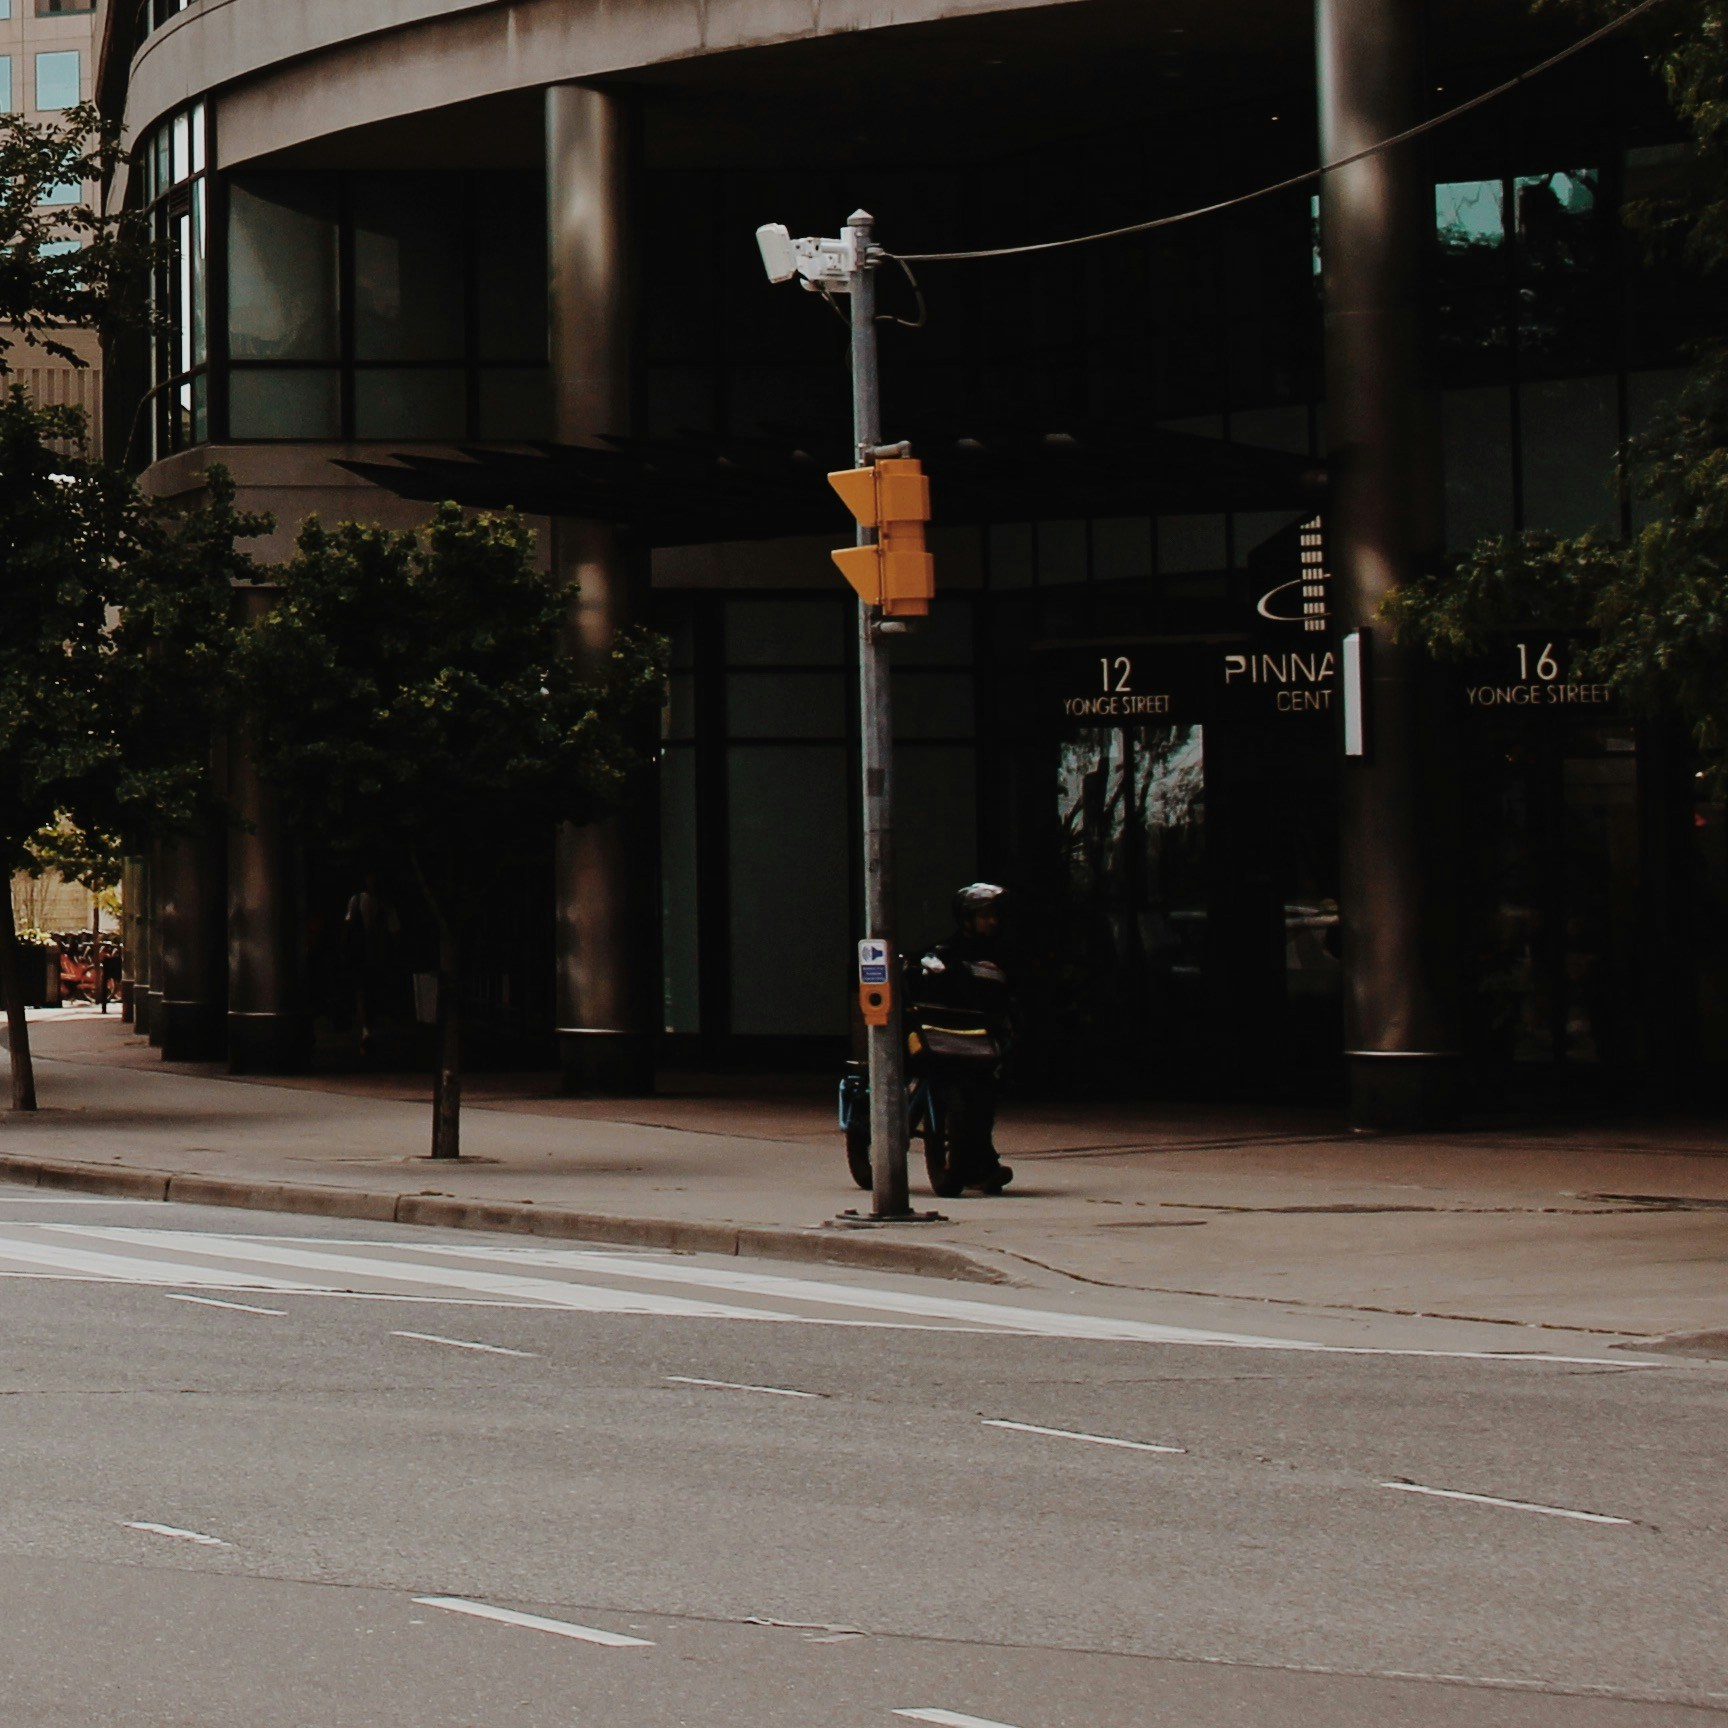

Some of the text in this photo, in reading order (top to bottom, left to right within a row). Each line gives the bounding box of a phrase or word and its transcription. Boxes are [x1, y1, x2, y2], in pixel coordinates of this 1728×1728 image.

[1100, 656, 1132, 692] 12
[1516, 642, 1558, 681] 16
[1064, 694, 1170, 716] YONGE STREET
[1466, 683, 1611, 706] YONGE STREET
